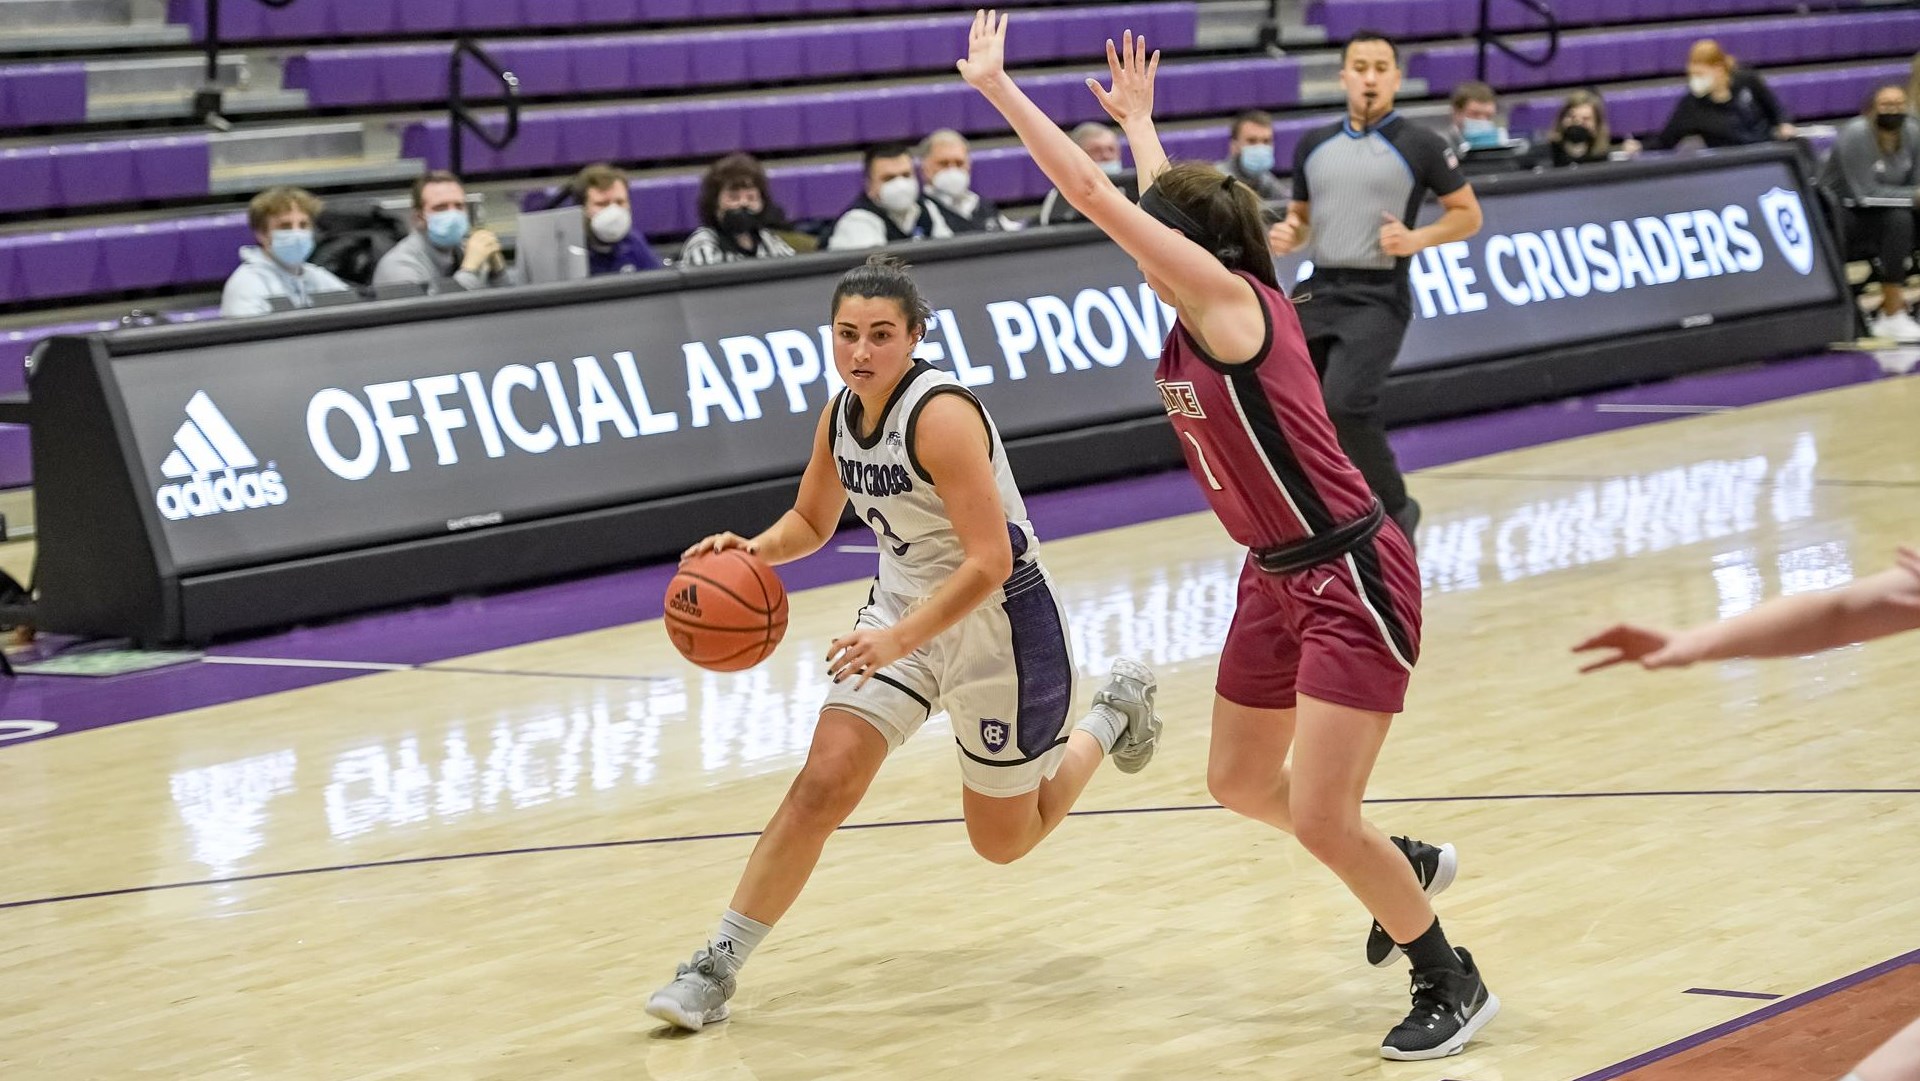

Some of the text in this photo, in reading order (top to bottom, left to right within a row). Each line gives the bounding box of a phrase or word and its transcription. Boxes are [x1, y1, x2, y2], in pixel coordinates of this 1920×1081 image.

[306, 350, 679, 481] OFFICIAL
[681, 308, 995, 428] APPEL
[1409, 240, 1488, 319] HE
[1484, 203, 1764, 307] CRUSADERS
[156, 464, 289, 521] adidas
[863, 463, 914, 498] CROSS
